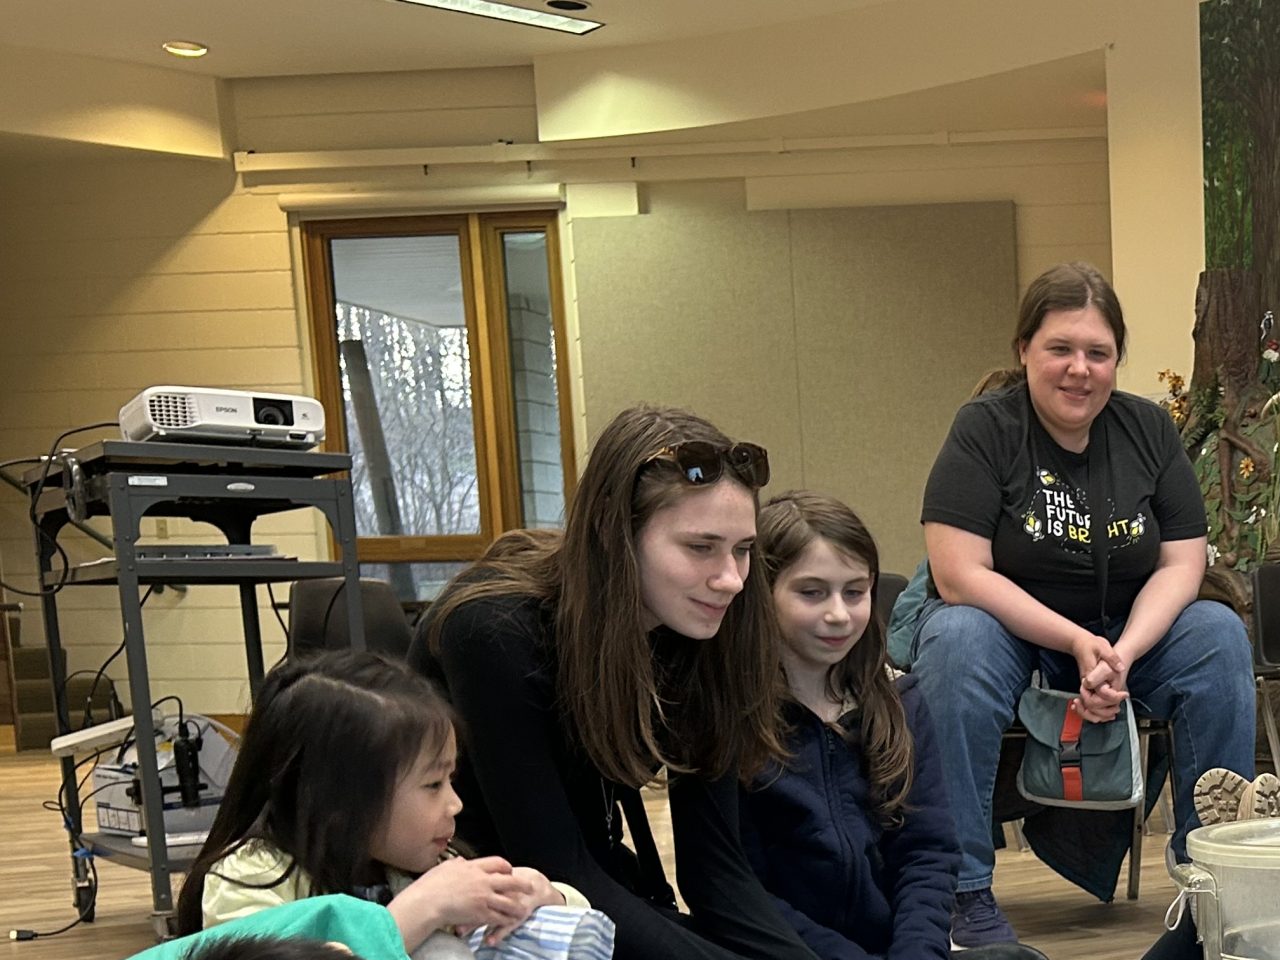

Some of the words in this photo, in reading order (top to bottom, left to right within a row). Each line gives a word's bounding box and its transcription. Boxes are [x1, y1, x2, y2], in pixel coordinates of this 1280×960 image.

[1042, 489, 1075, 509] THE
[1047, 518, 1064, 537] IS
[1068, 519, 1129, 544] BRHT
